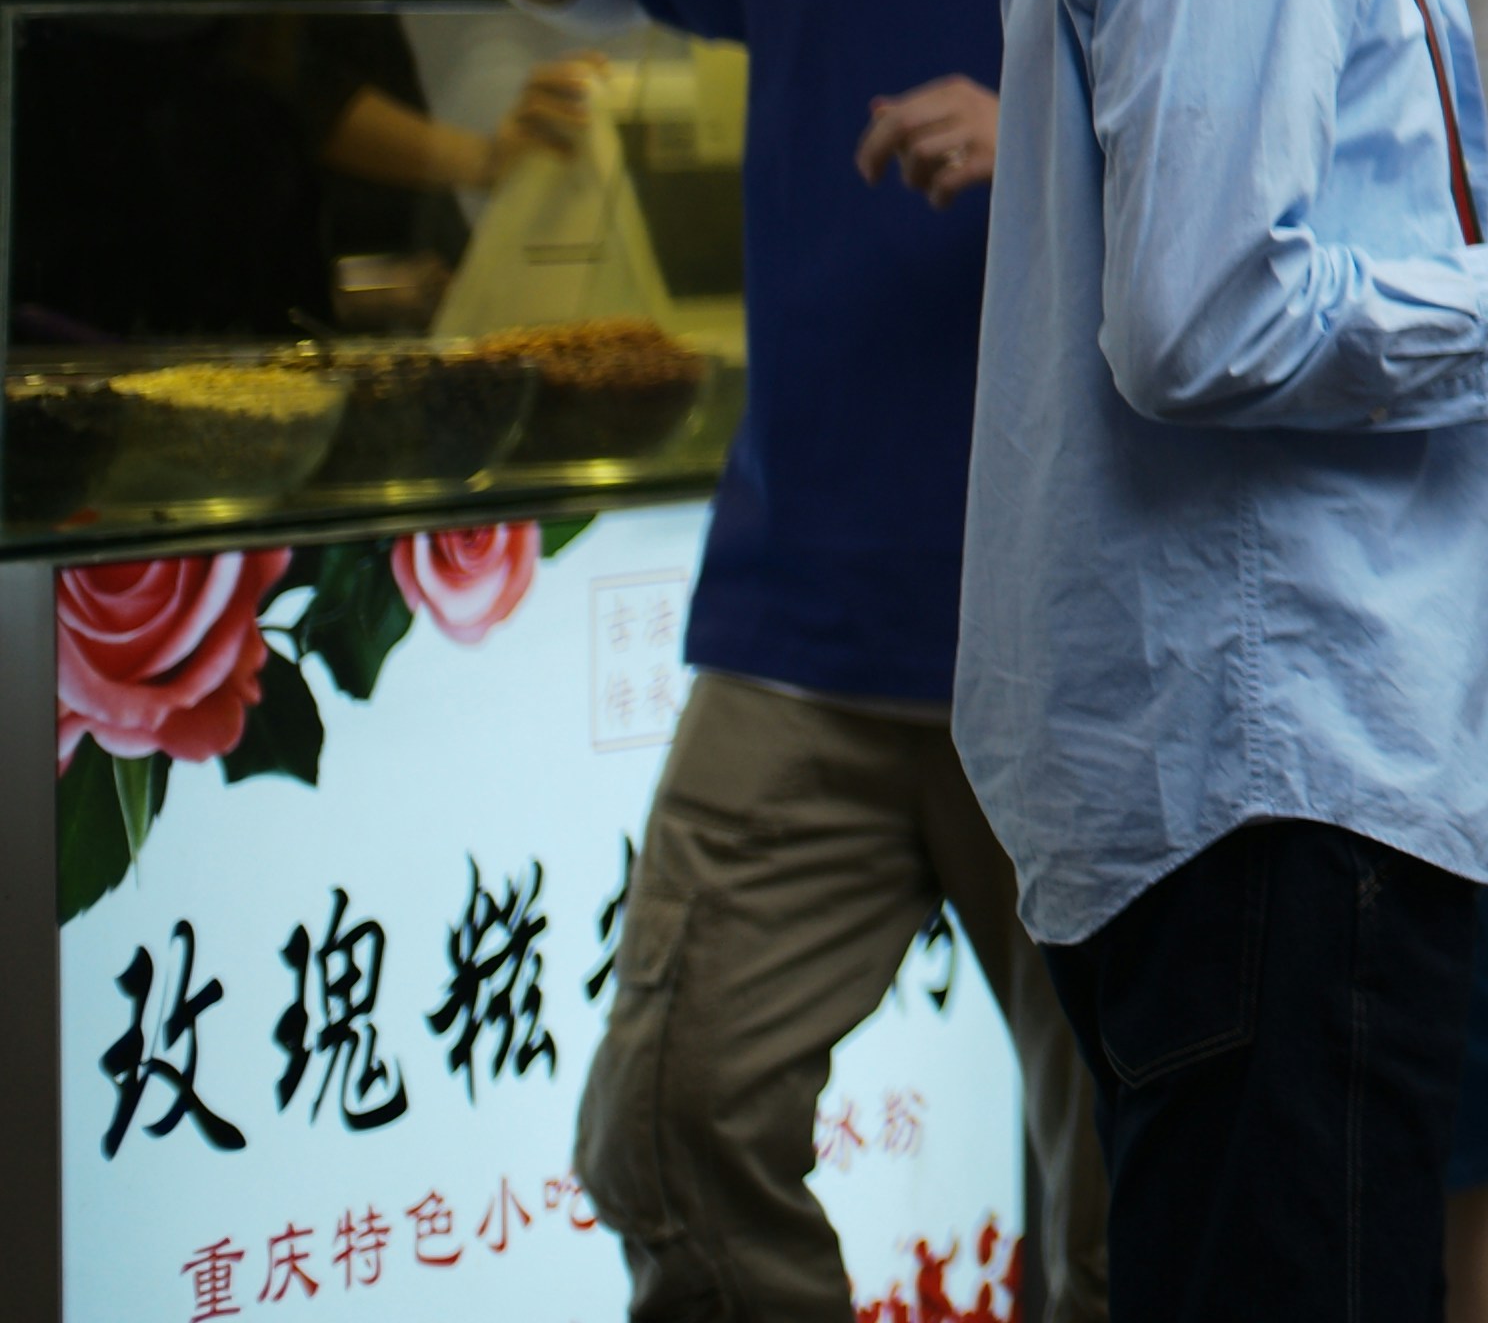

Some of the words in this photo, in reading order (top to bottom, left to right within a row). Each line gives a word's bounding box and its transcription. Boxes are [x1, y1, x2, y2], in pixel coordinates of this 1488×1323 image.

[180, 1171, 600, 1322] 重庆特色小吃
